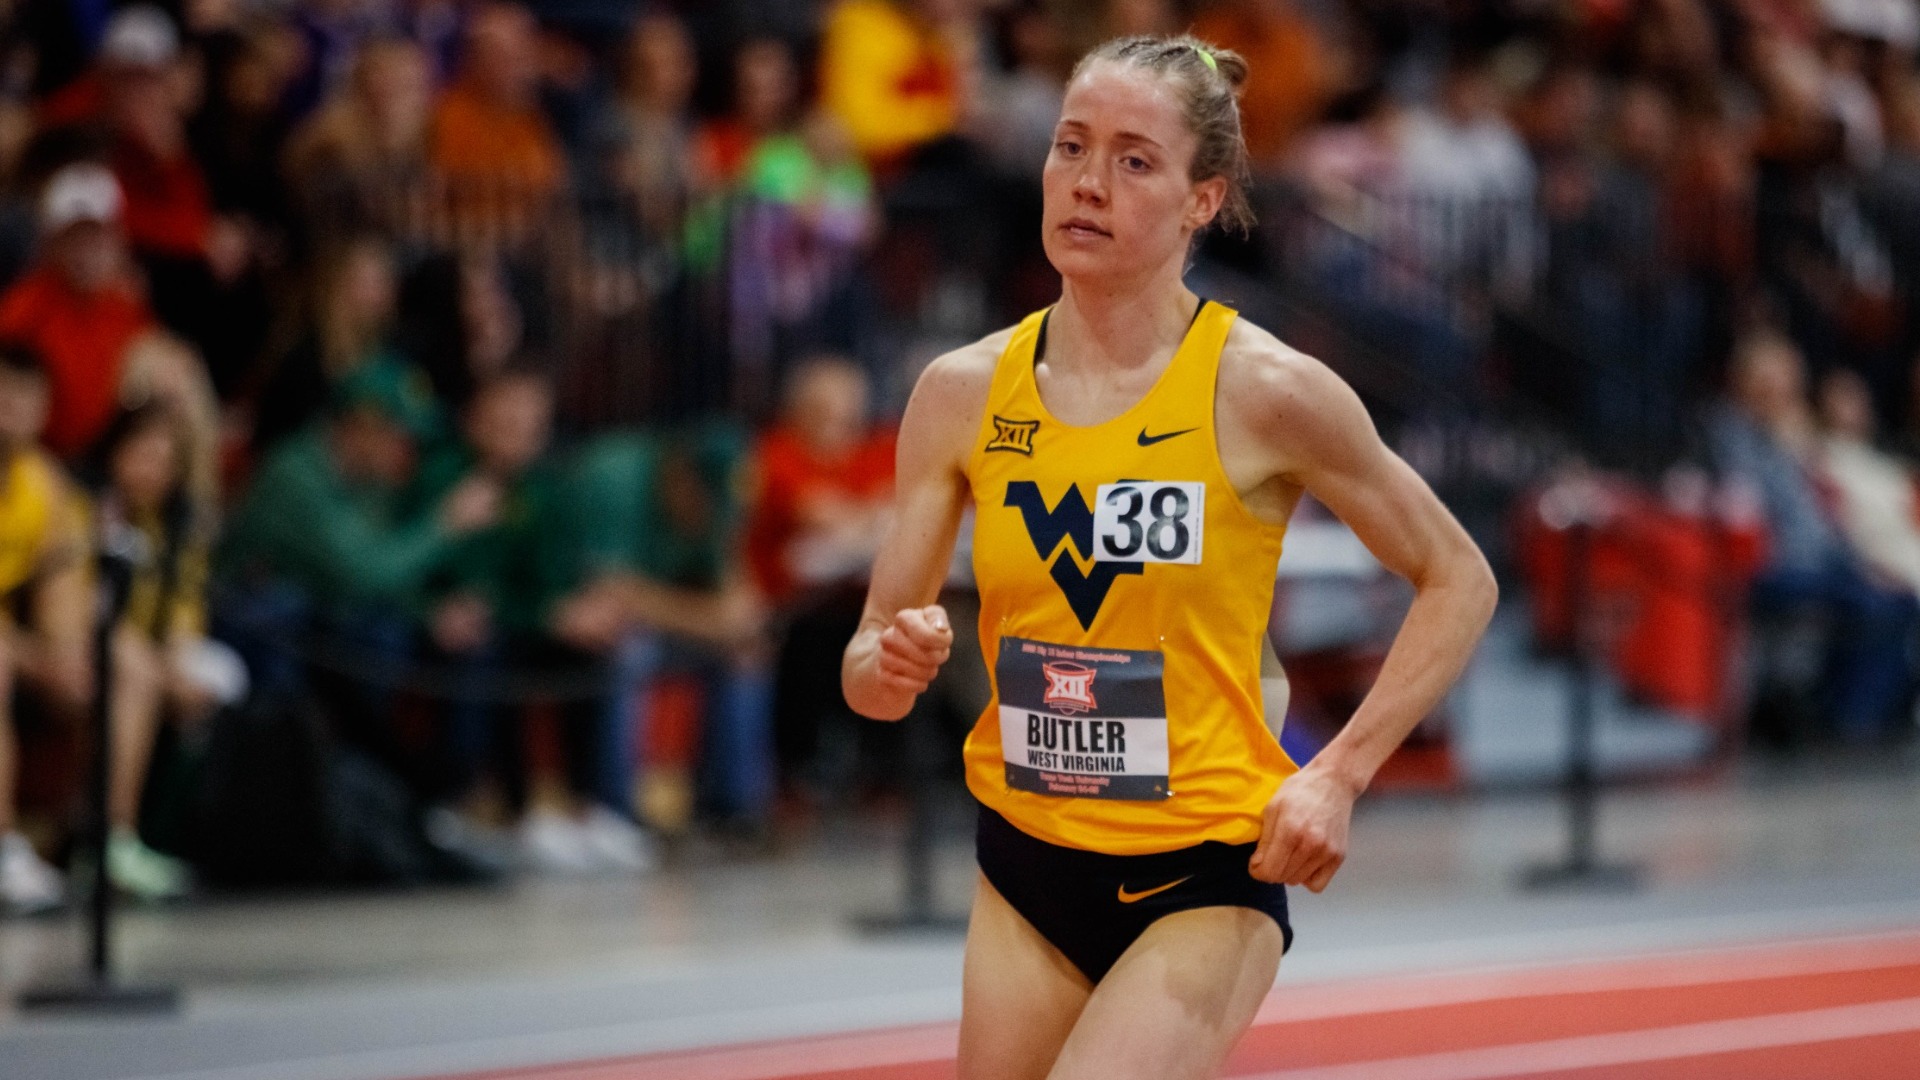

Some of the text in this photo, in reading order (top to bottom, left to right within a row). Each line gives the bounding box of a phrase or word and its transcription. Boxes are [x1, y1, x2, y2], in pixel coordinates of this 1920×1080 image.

[987, 416, 1039, 457] XII
[1102, 486, 1190, 560] 38
[1045, 668, 1095, 705] XII
[1027, 713, 1126, 753] BUTLER
[1028, 750, 1126, 772] WEST VIRGINIA
